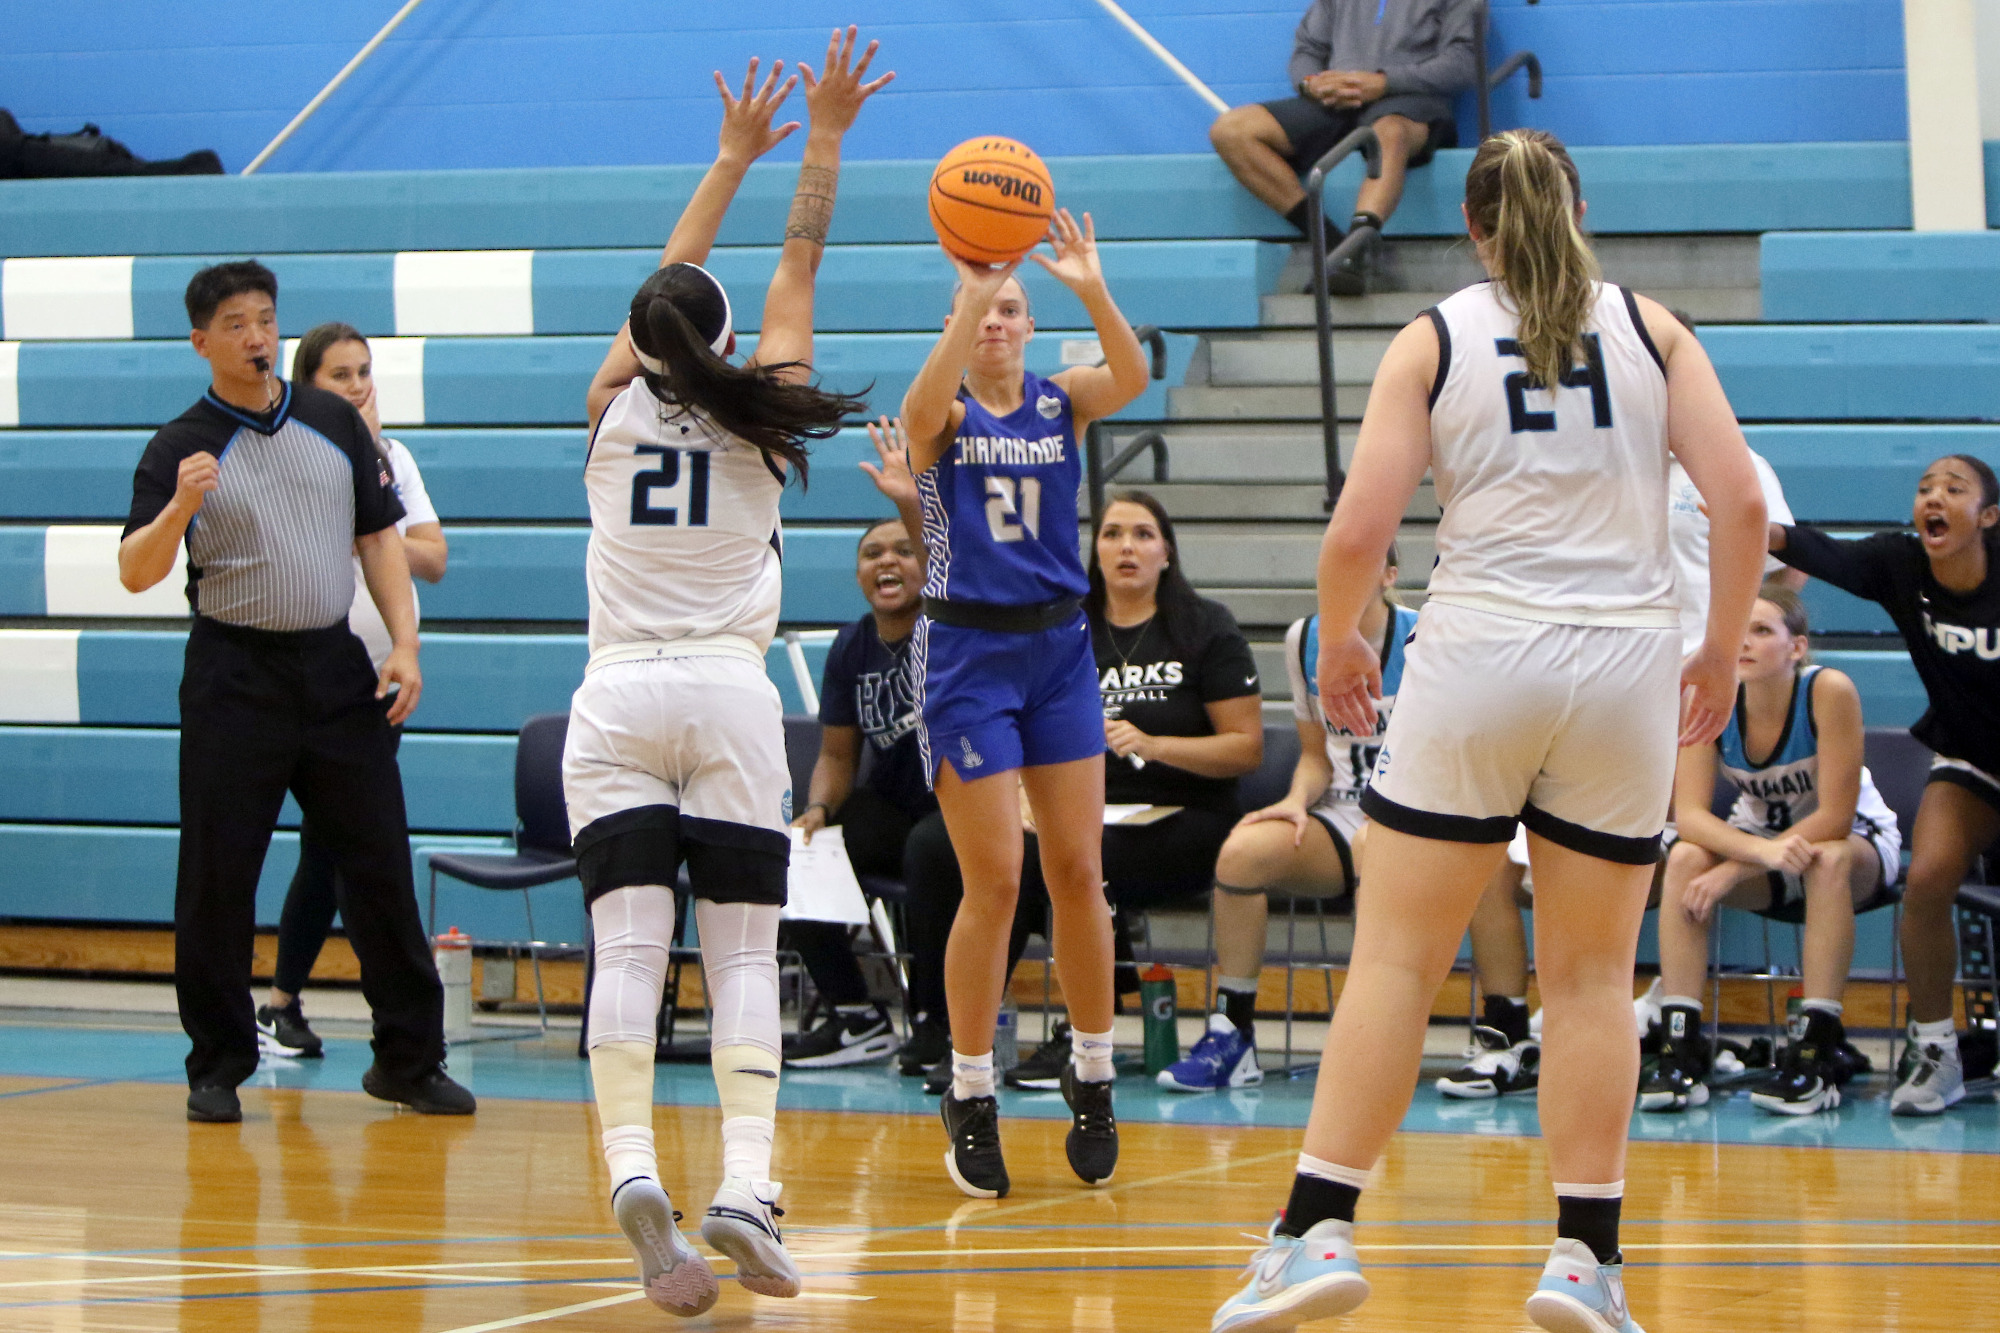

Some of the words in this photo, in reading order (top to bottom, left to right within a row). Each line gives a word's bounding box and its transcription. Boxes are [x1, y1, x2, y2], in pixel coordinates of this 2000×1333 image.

[963, 170, 1041, 206] Wilson
[1493, 332, 1613, 434] 24
[629, 443, 710, 527] 21
[984, 476, 1042, 542] 21
[1097, 661, 1184, 689] ARKS
[1153, 996, 1173, 1020] G
